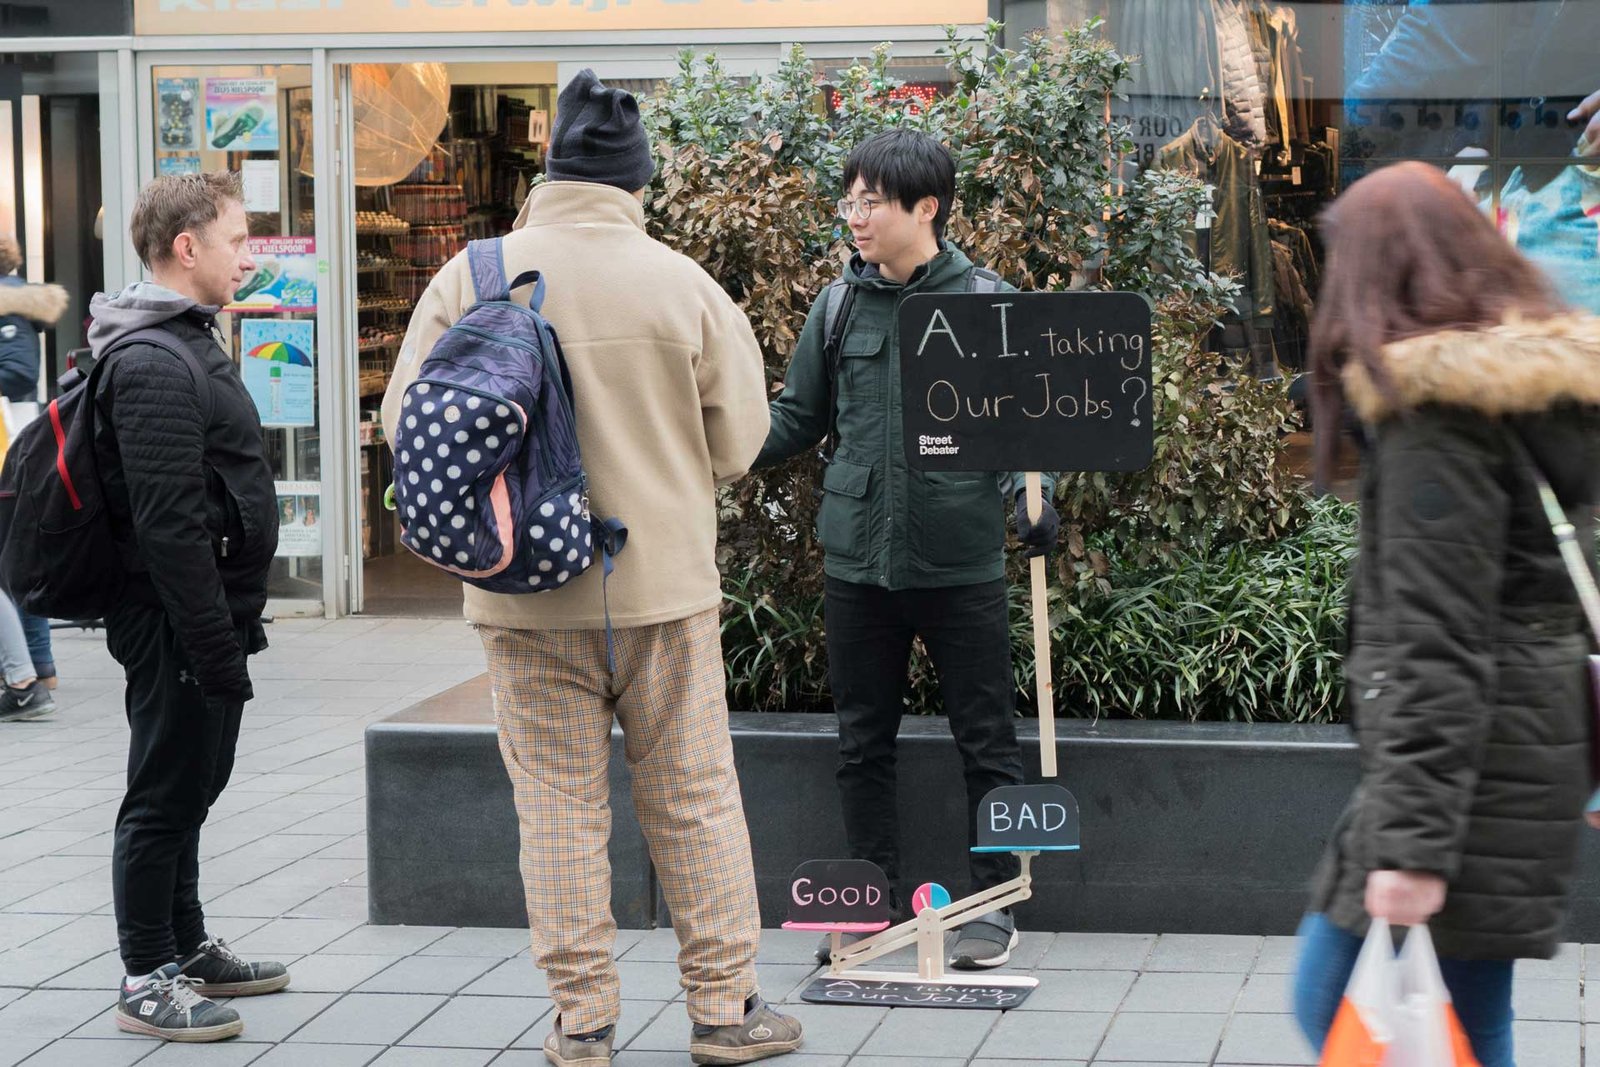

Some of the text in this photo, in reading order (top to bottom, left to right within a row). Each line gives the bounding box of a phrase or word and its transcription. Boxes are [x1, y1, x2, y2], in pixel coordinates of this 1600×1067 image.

[1040, 327, 1143, 371] taking
[927, 379, 1014, 422] Our
[918, 434, 953, 445] Street
[919, 445, 960, 455] Debater
[990, 802, 1066, 832] BAD
[791, 877, 881, 906] GOOD
[825, 990, 900, 1000] Our
[913, 985, 1003, 998] taking
